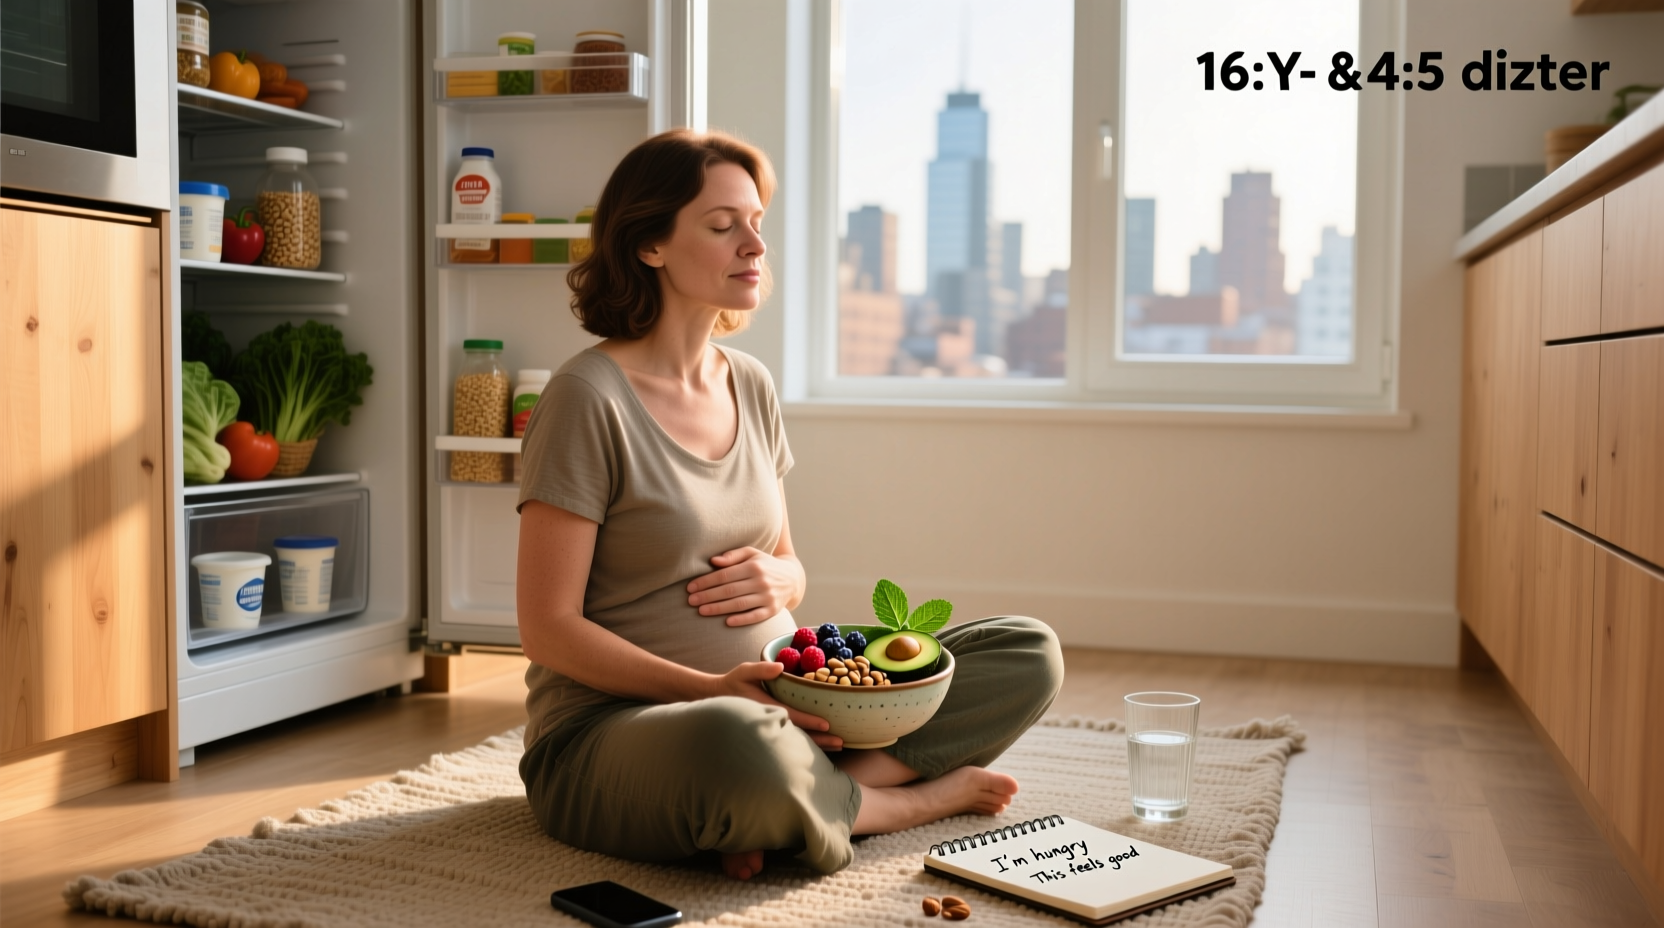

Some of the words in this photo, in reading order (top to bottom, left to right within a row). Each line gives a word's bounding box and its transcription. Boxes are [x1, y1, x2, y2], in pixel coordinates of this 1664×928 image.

[990, 854, 1029, 873] I'm
[1029, 840, 1088, 861] hungry
[1029, 870, 1067, 884] This
[1069, 857, 1105, 875] feels
[1108, 845, 1140, 870] good
